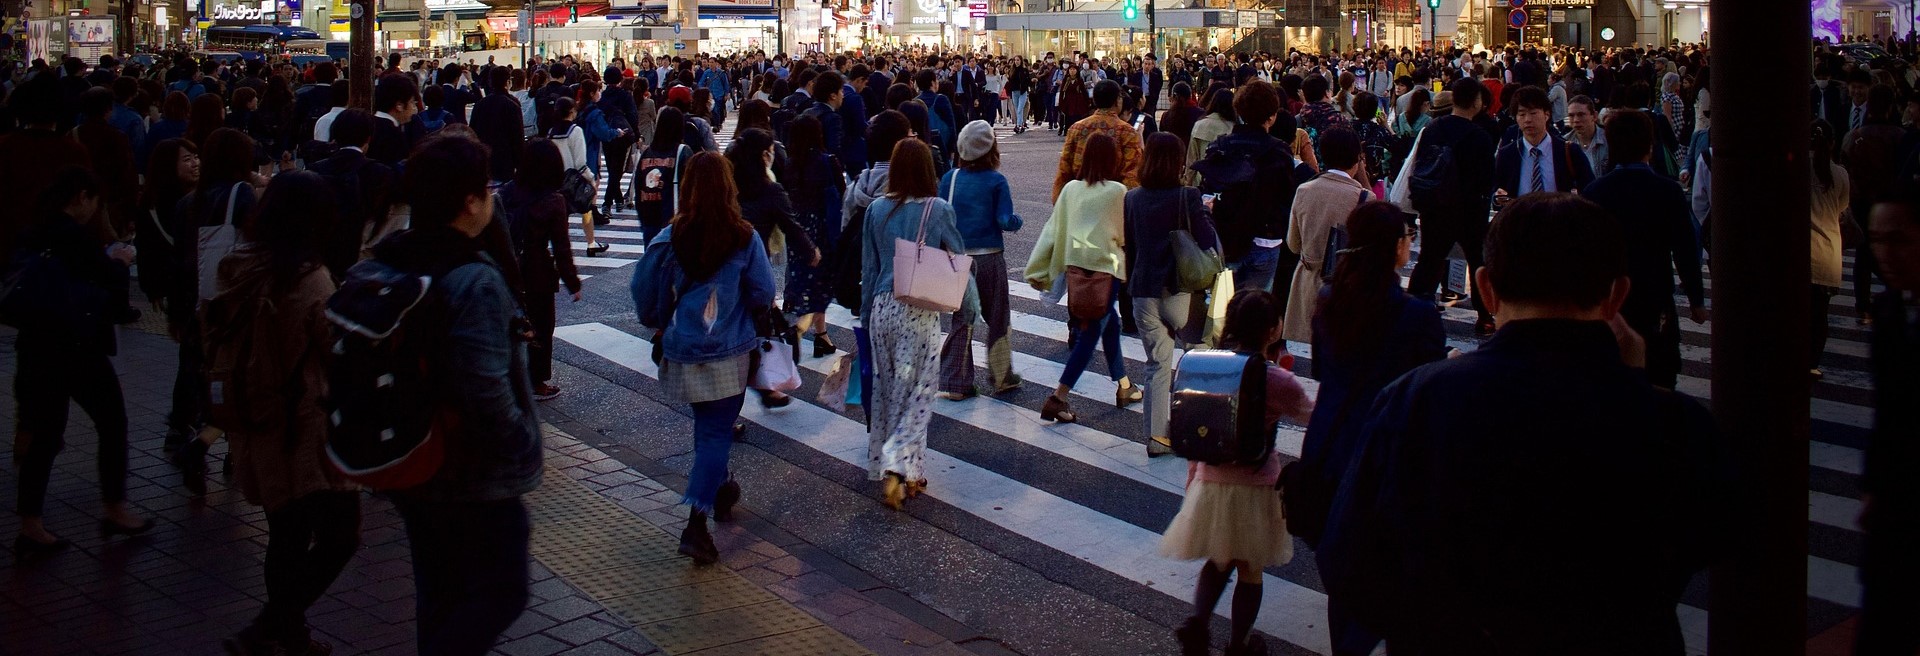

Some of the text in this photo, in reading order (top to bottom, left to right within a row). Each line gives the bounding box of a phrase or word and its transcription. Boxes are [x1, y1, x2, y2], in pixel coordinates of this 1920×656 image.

[214, 3, 261, 20] グルメタウン
